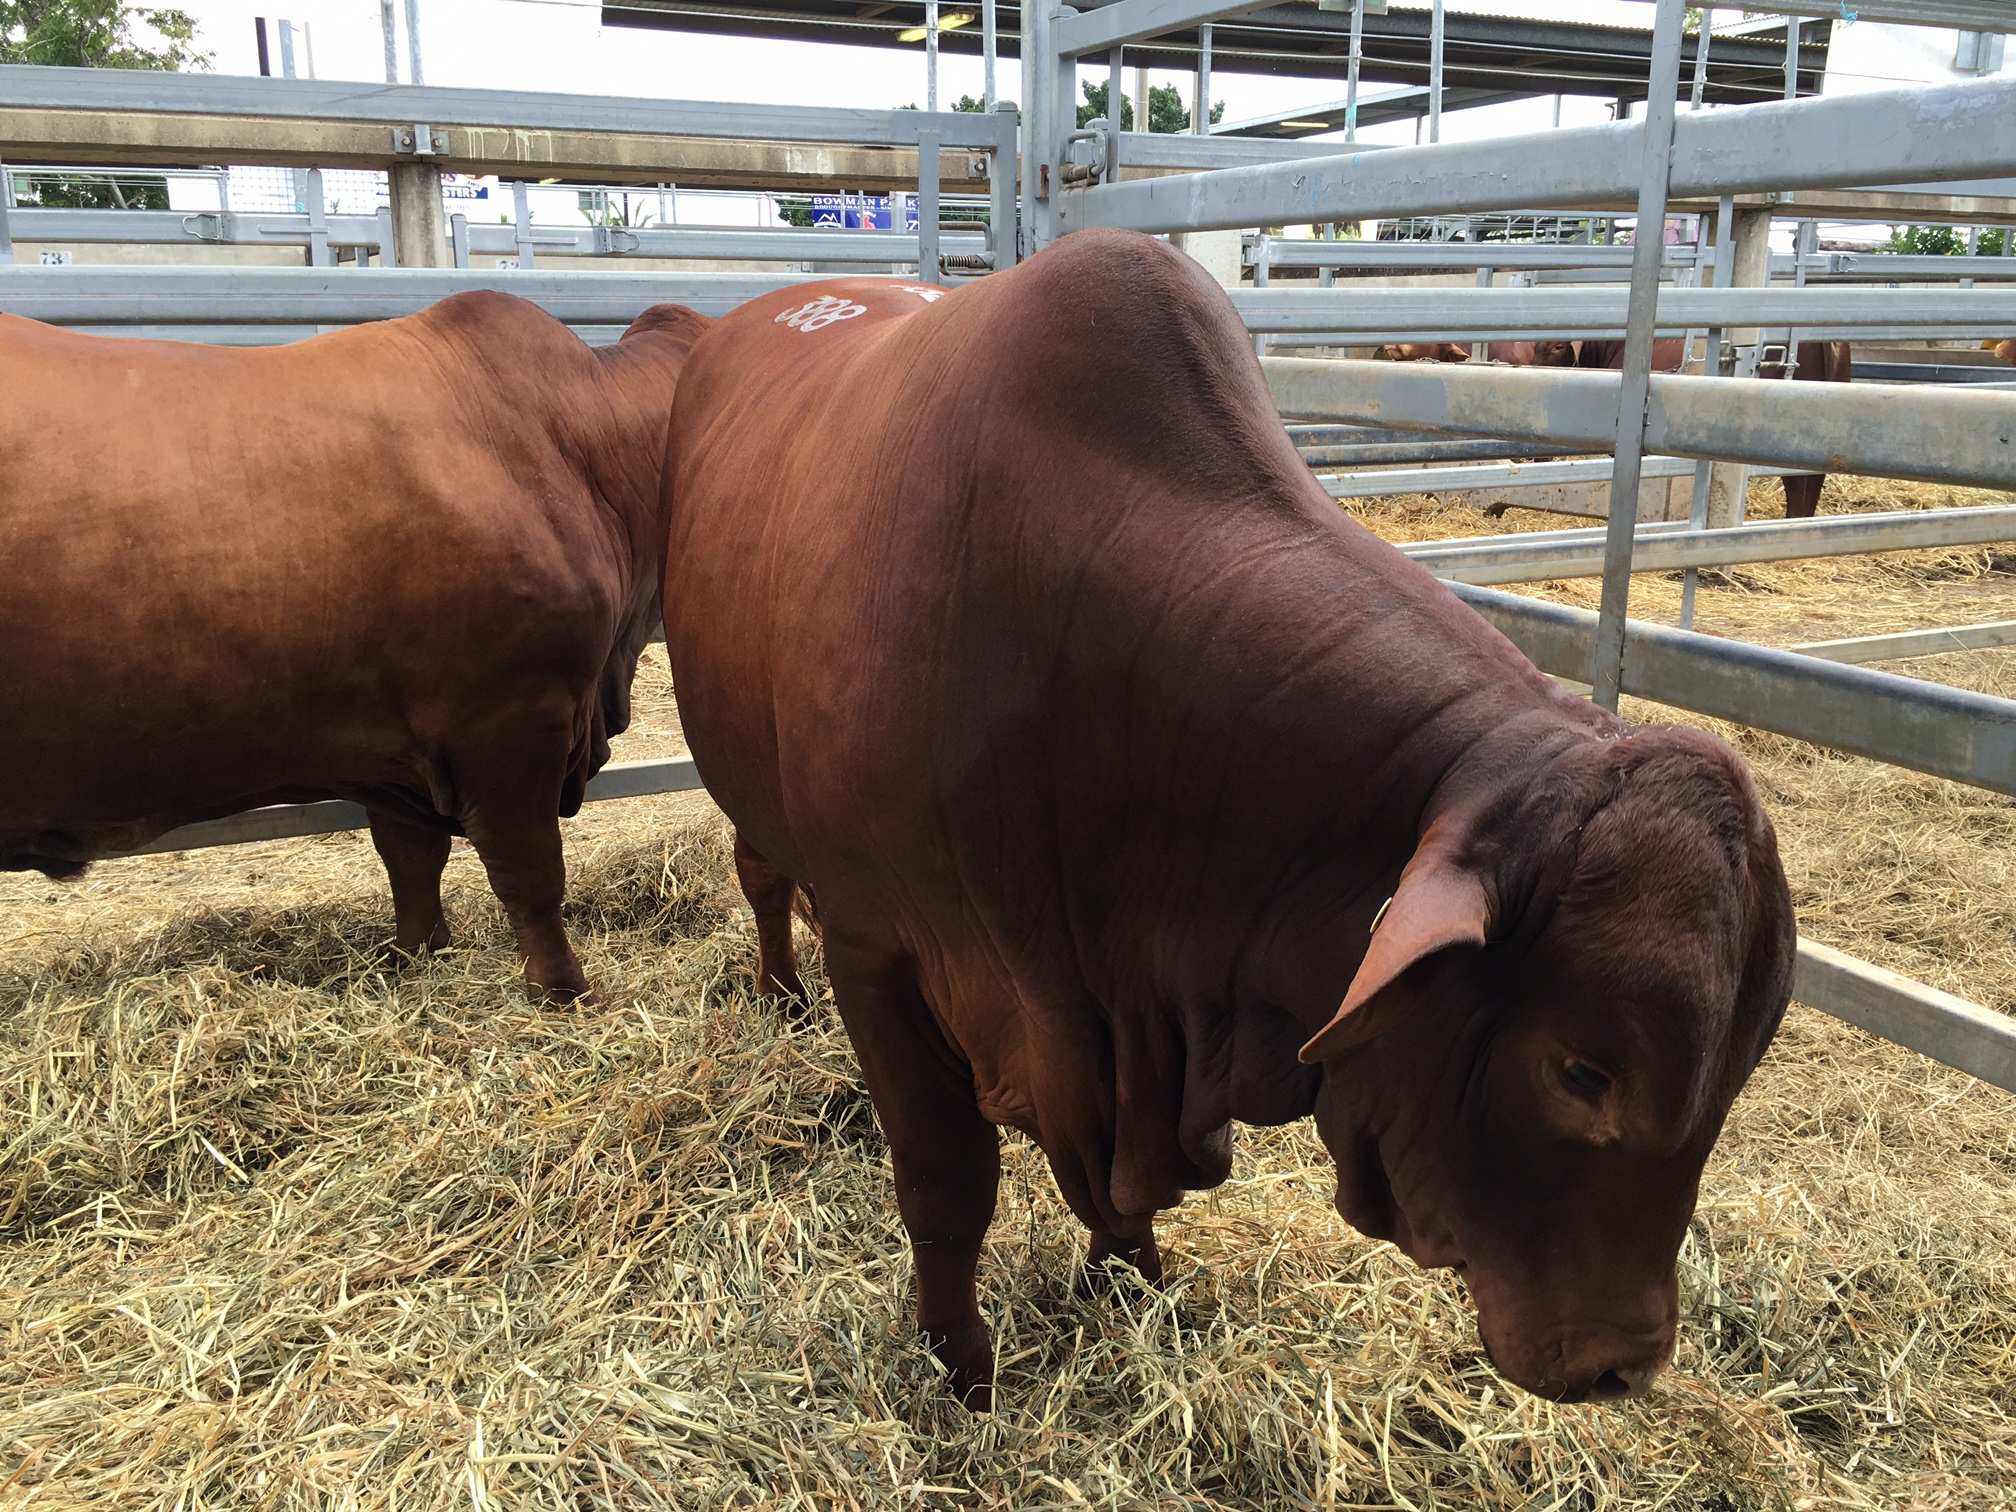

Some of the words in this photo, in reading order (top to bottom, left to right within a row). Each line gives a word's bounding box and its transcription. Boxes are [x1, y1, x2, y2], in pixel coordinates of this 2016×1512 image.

[813, 197, 876, 206] BOWMAN
[880, 199, 917, 207] PK
[40, 252, 64, 265] 73
